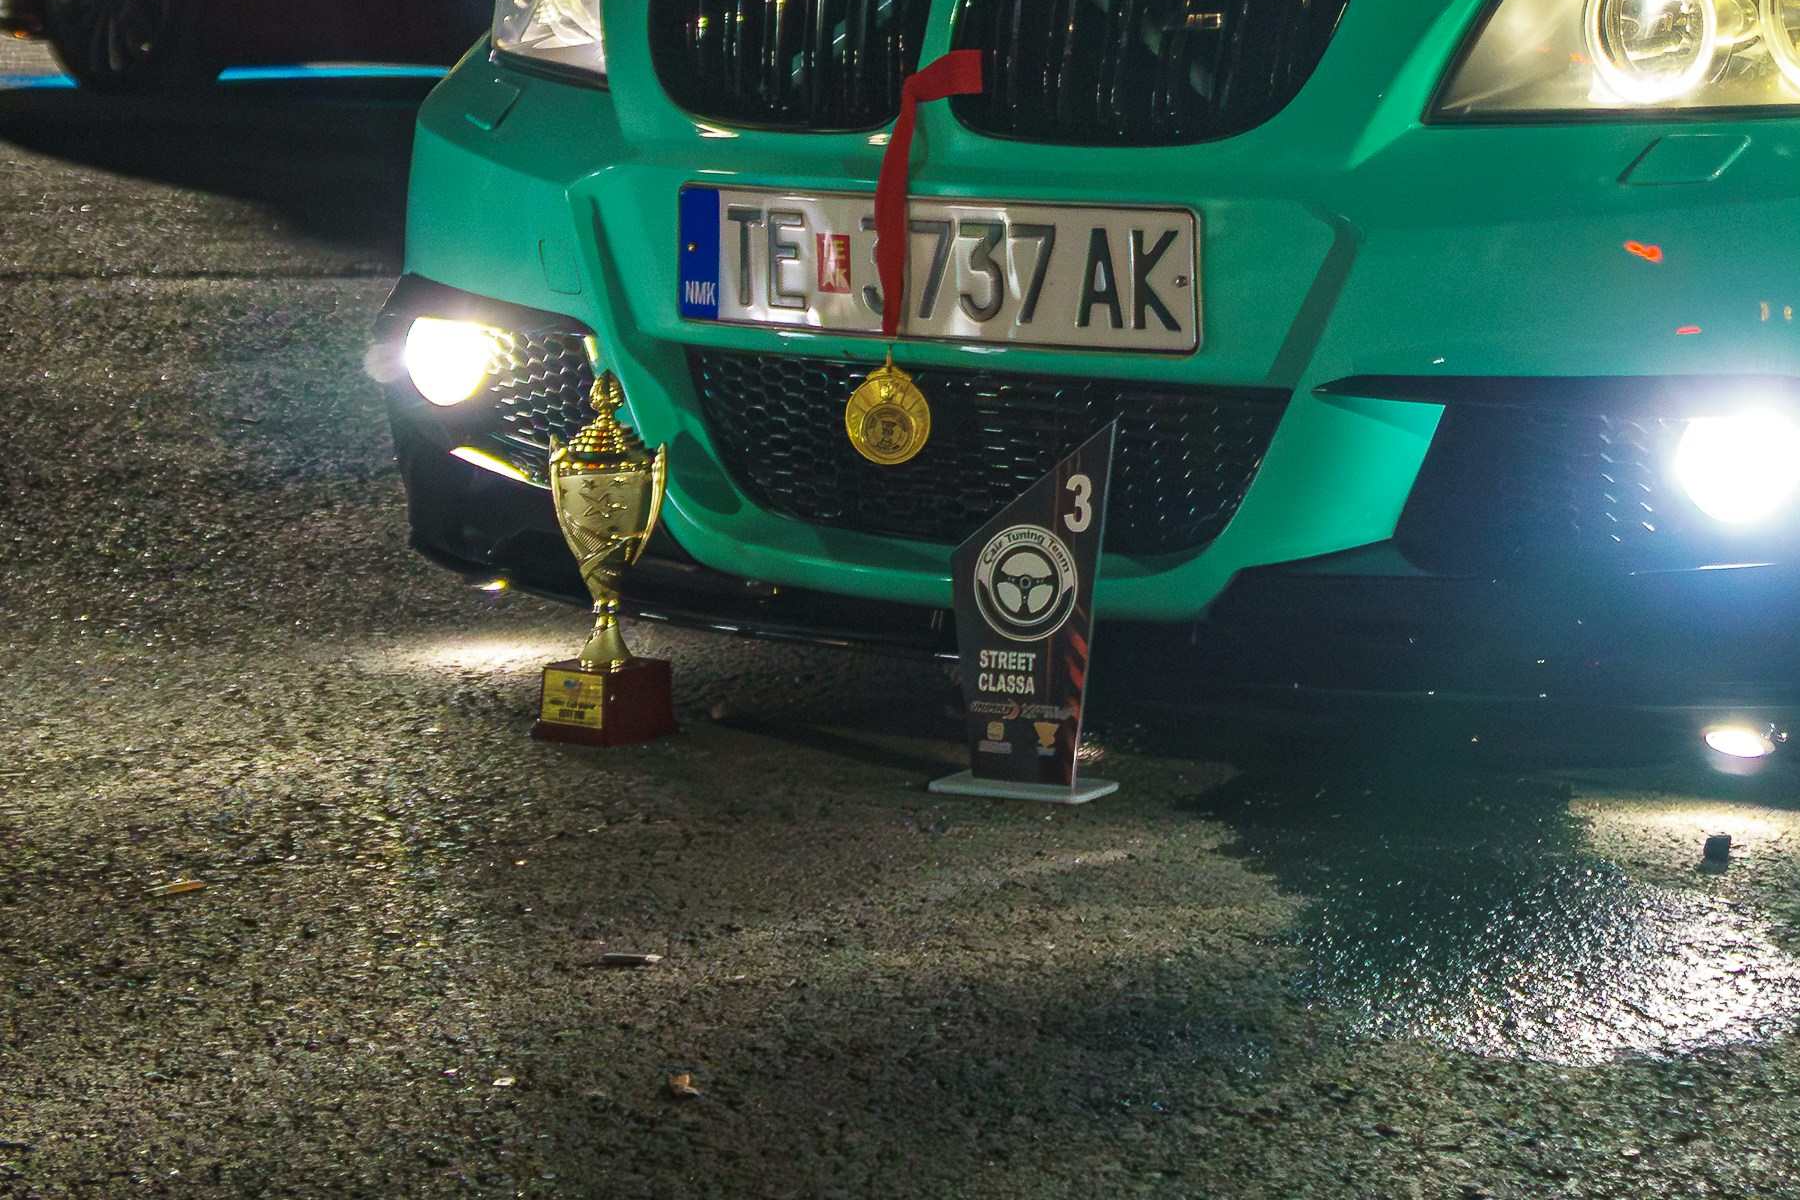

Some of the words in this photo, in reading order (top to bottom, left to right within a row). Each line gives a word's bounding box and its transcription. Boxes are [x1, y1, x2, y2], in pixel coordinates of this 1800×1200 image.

[727, 203, 809, 310] TE
[1074, 227, 1182, 332] AK
[685, 280, 717, 306] NMK
[1063, 474, 1092, 533] 3
[1003, 530, 1046, 545] Tuning
[1047, 539, 1070, 573] Team
[979, 649, 1037, 672] STREET
[978, 672, 1035, 695] CLASSA
